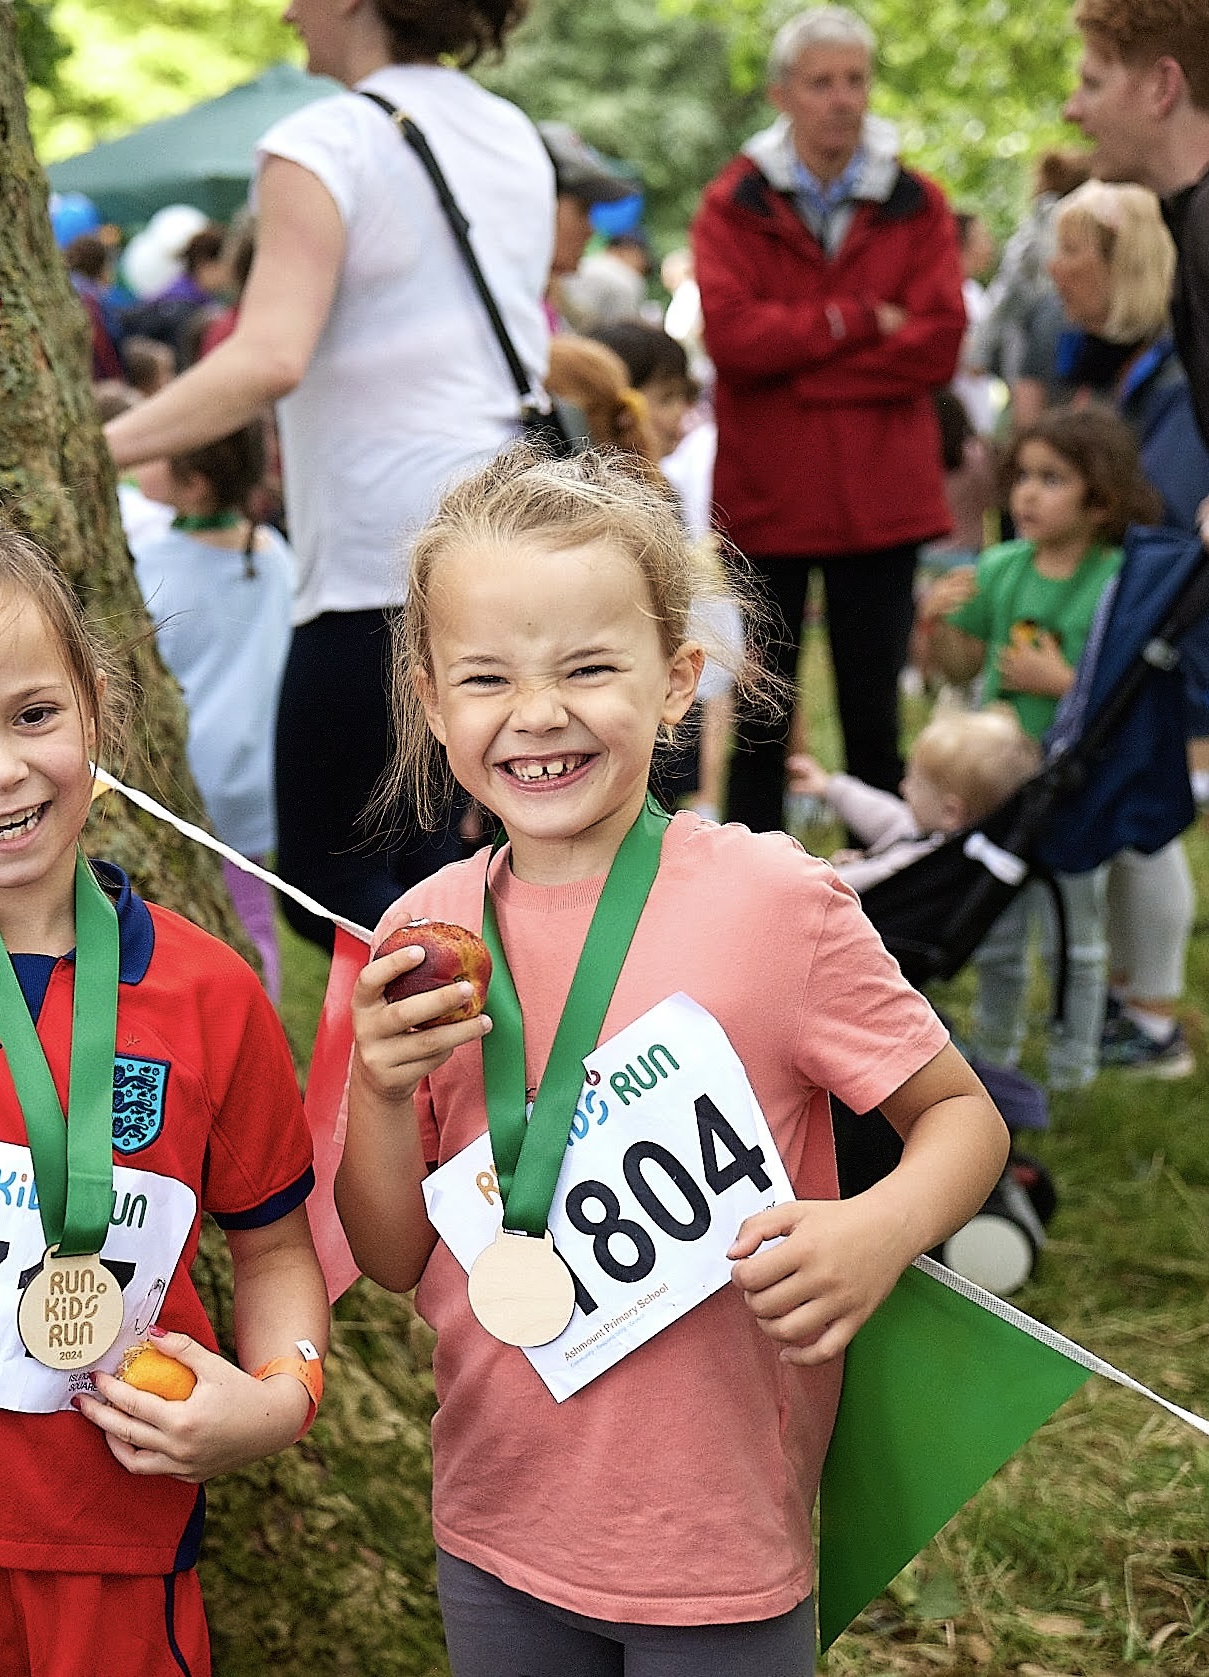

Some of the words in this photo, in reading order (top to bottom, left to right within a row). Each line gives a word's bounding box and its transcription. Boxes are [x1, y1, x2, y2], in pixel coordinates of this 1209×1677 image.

[567, 1089, 609, 1146] DS
[610, 1043, 680, 1106] RUN
[109, 1189, 148, 1228] UN
[49, 1269, 95, 1296] RUN
[48, 1321, 94, 1348] RUN
[564, 1328, 606, 1362] Ashmount
[602, 1305, 639, 1333] Primary
[636, 1282, 670, 1309] School
[59, 1350, 83, 1361] 2024
